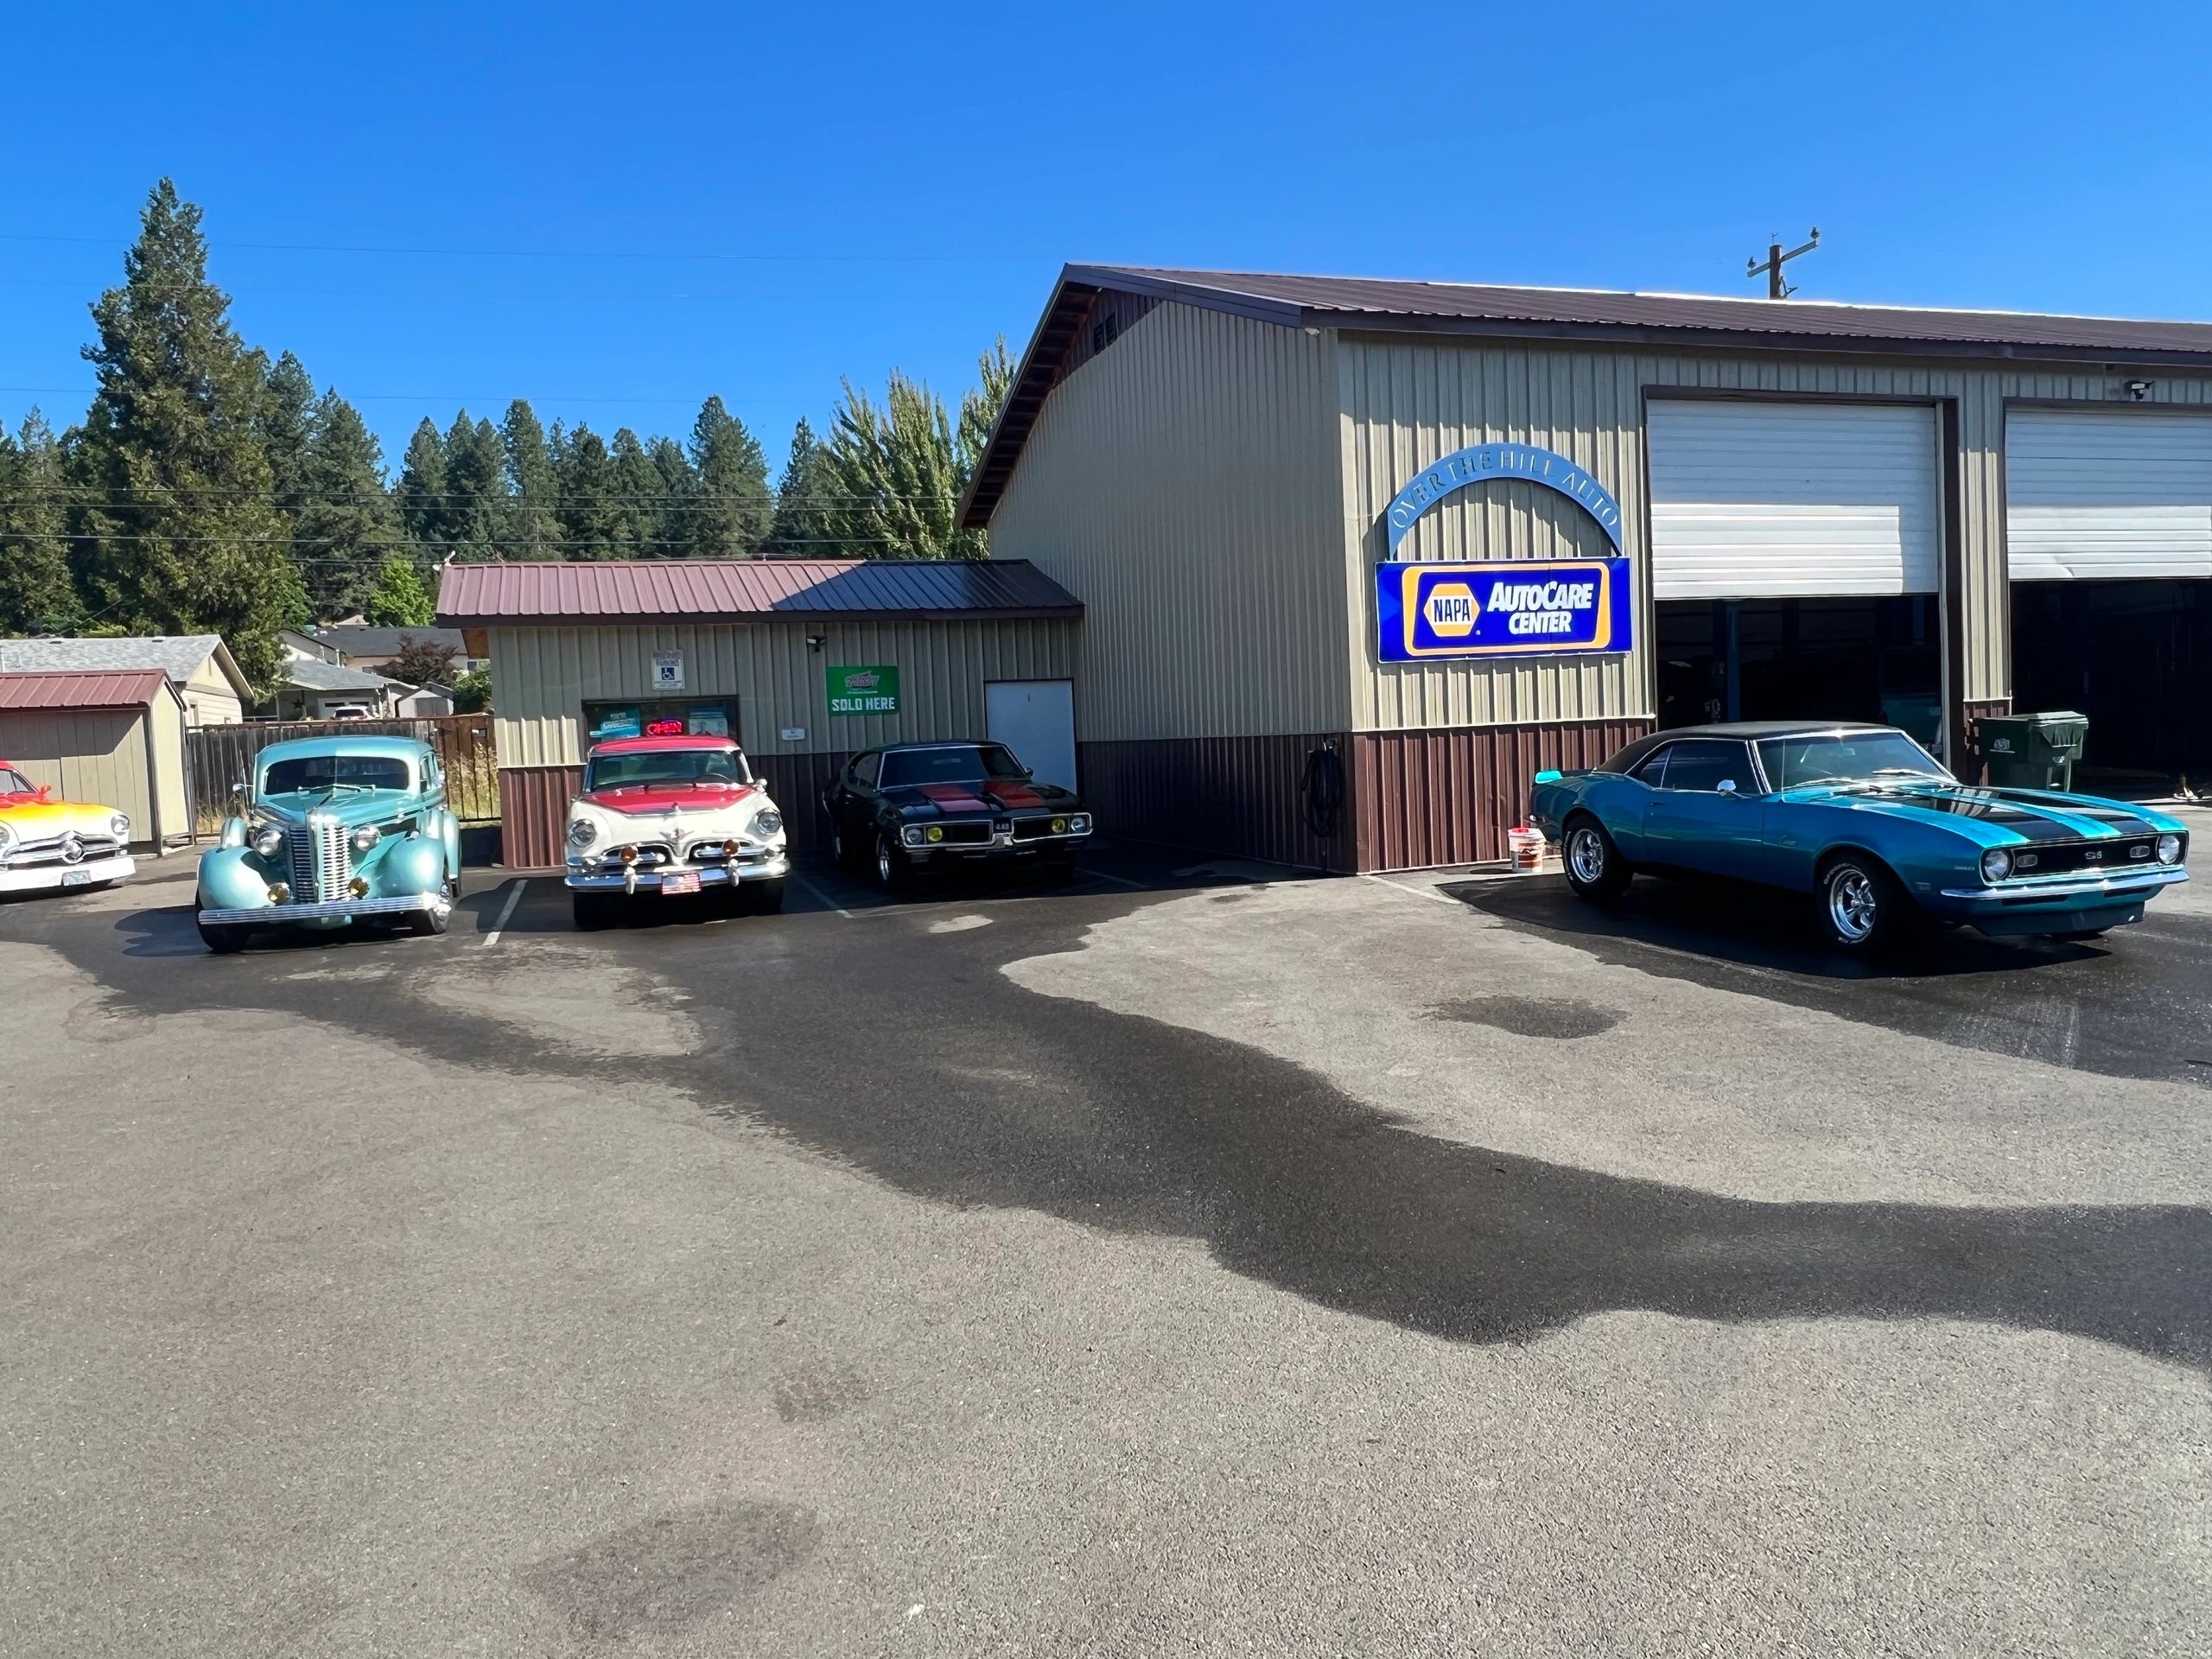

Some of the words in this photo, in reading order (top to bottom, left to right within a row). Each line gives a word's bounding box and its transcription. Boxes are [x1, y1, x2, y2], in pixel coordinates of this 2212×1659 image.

[1392, 472, 1446, 529] OVER
[1447, 450, 1494, 481] THE
[1500, 449, 1556, 477] HILL
[1561, 472, 1618, 527] AUTO
[1433, 598, 1471, 623] NAPA
[1508, 611, 1573, 635] CENTER
[831, 698, 863, 711] SOLD
[865, 697, 895, 710] HERE
[646, 721, 683, 734] OPEN
